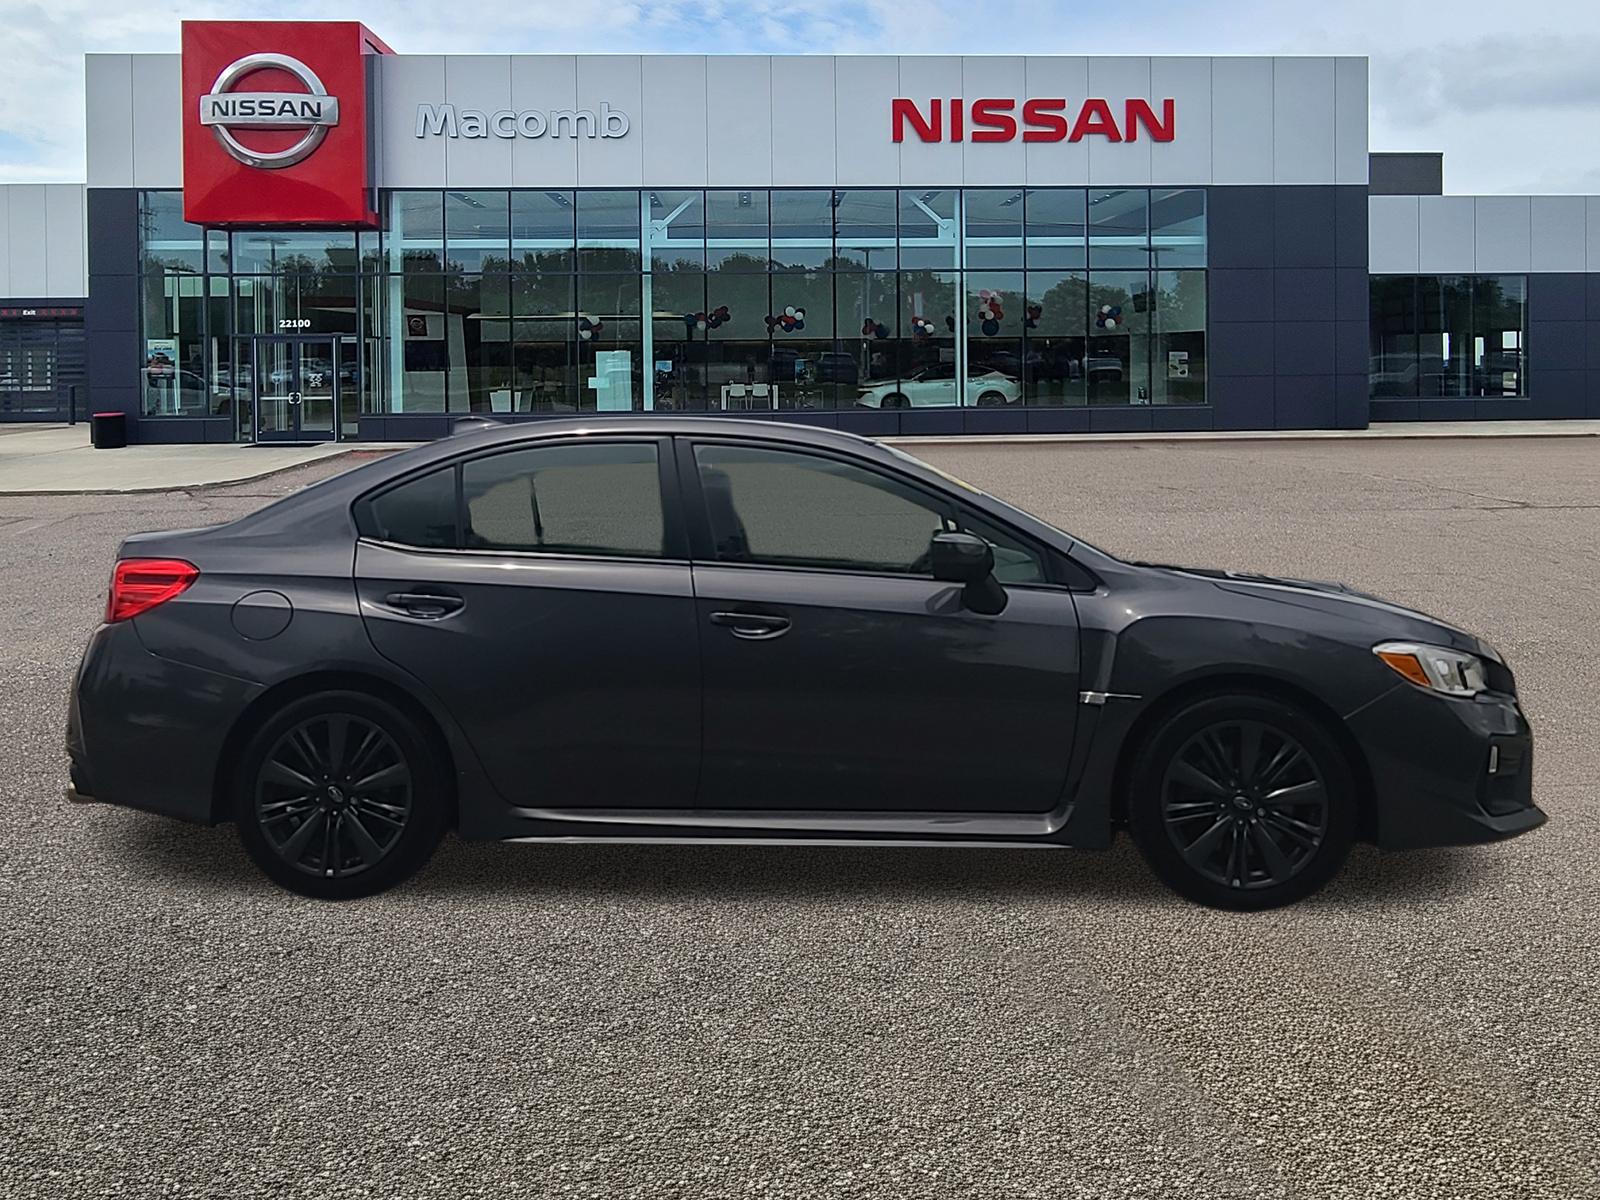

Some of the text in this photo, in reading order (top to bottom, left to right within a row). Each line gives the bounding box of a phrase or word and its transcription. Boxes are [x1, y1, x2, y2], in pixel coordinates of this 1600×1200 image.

[211, 100, 322, 118] NISSAN
[415, 101, 630, 139] Macomb
[892, 98, 1175, 143] NISSAN
[279, 319, 311, 328] 22100
